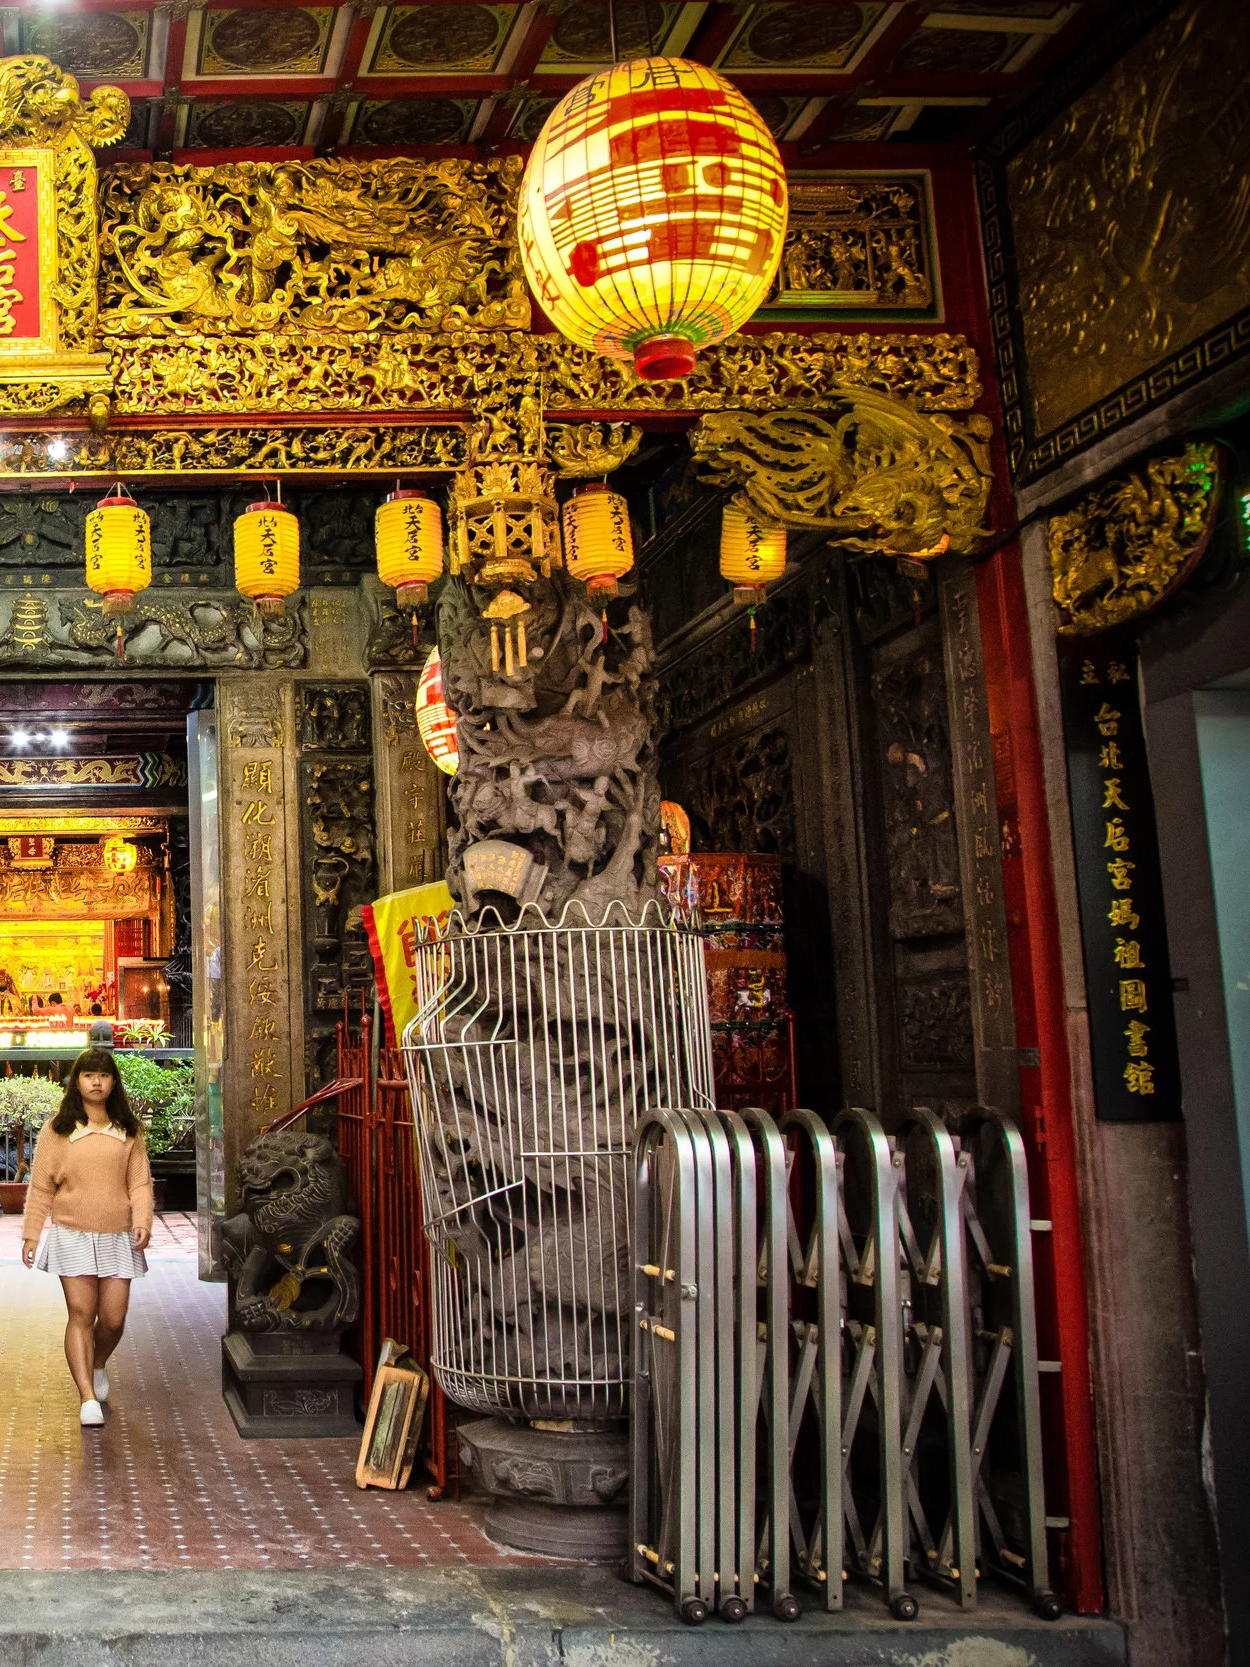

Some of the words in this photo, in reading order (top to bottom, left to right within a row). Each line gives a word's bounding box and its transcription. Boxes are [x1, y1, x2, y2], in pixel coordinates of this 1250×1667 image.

[89, 523, 104, 570] 天后宮
[258, 528, 278, 575] 天后宮
[404, 515, 423, 562] 天后宮
[1079, 660, 1131, 685] 私立
[1092, 702, 1156, 1096] 台北天后宮媽祖圖書館
